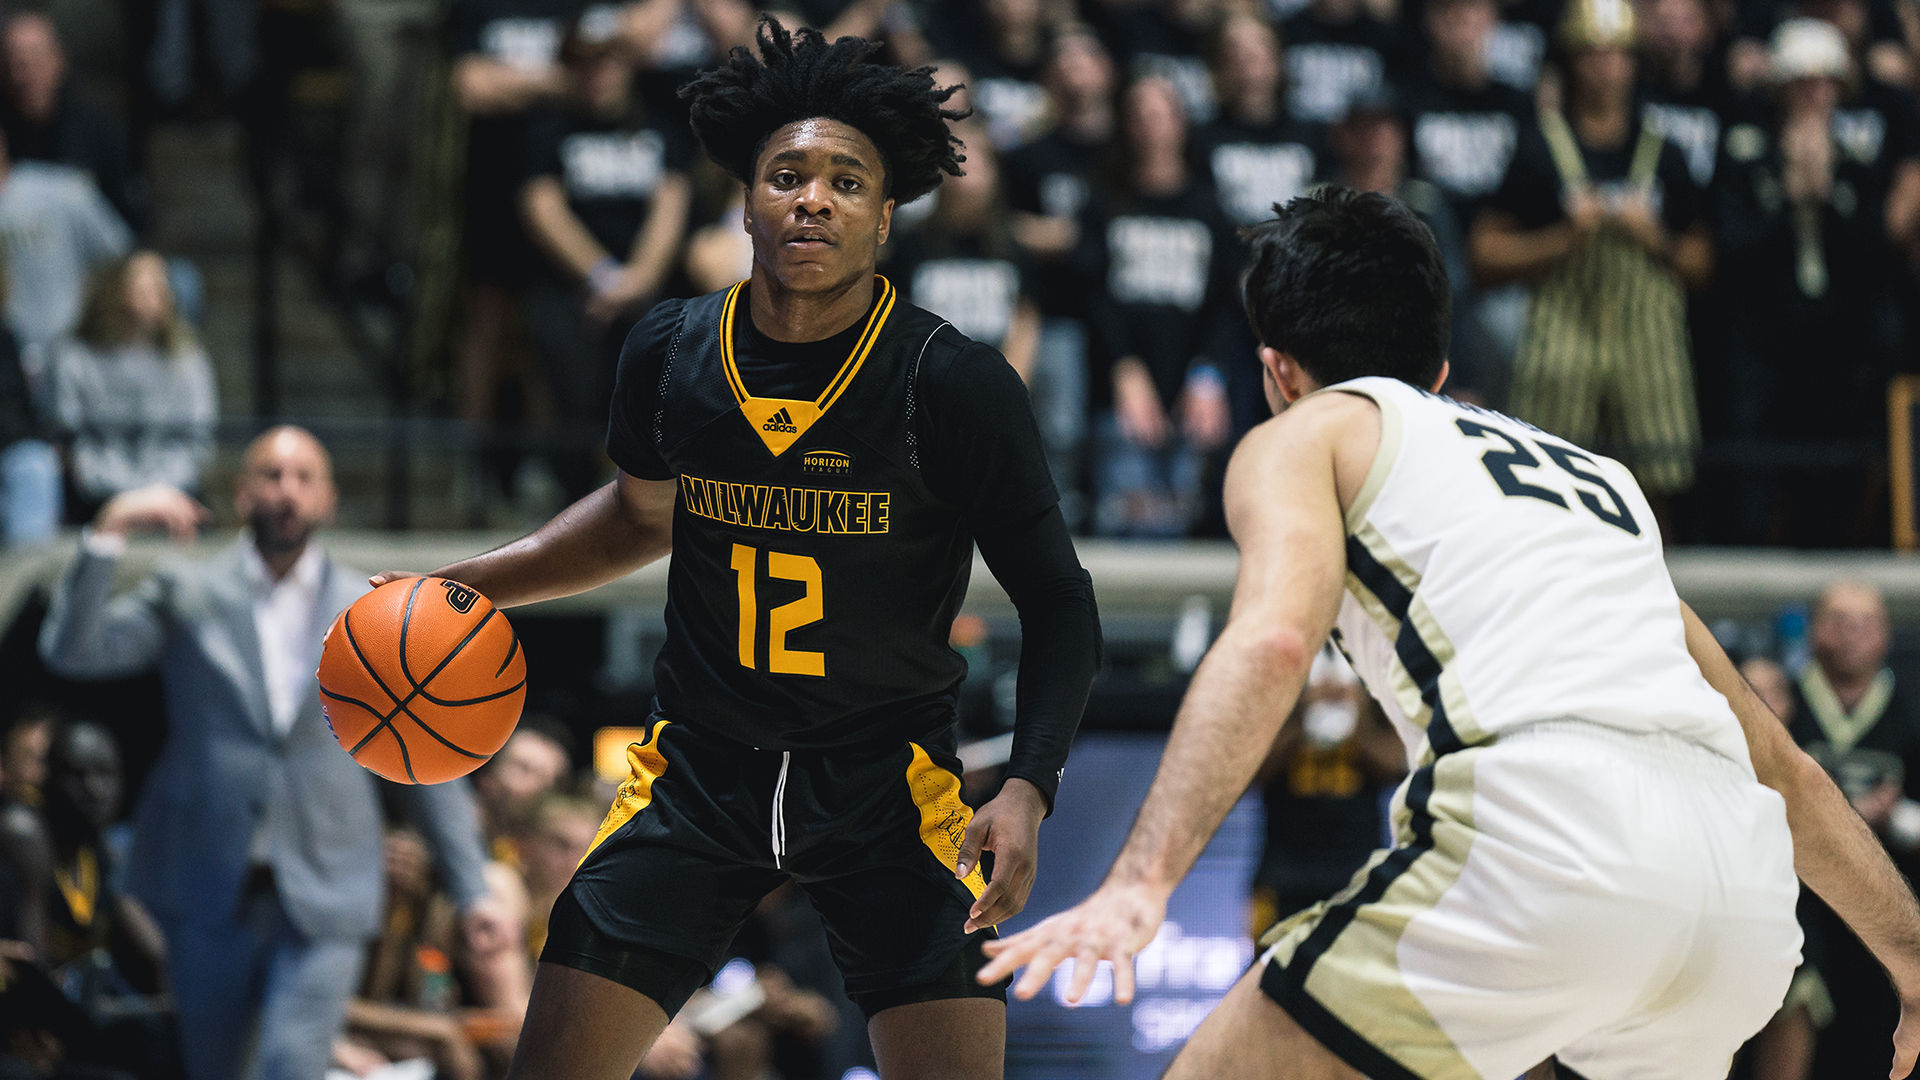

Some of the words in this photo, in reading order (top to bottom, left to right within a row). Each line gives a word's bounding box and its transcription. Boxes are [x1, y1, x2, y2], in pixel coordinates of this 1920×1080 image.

[762, 422, 798, 434] adidas
[803, 456, 850, 468] HORIZON
[803, 466, 849, 474] LEAGUE
[1453, 416, 1644, 540] 25
[680, 473, 891, 535] MILWAUKEE
[730, 542, 826, 677] 12
